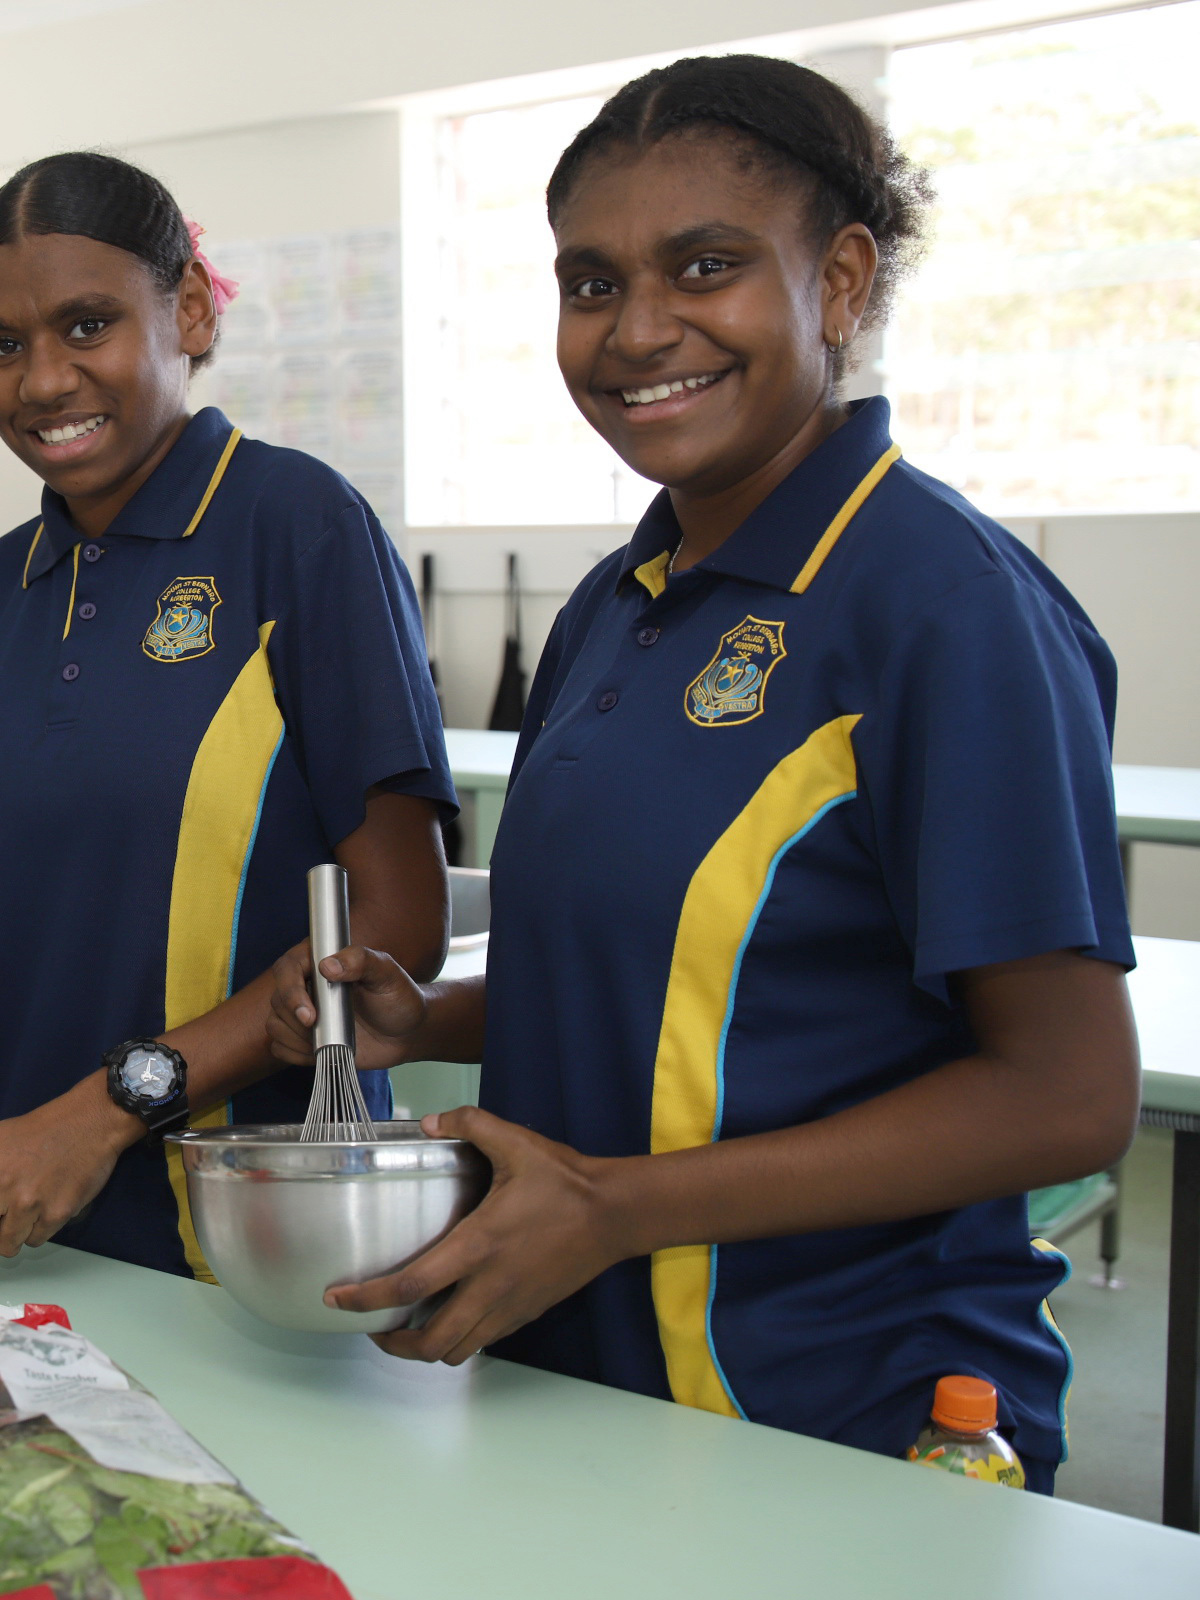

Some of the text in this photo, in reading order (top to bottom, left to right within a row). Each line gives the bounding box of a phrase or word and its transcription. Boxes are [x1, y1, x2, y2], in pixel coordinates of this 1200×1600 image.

[161, 583, 183, 601] MOUNT
[192, 580, 216, 602] BERNARD
[726, 625, 752, 645] MOUNT
[759, 626, 779, 655] BERNARD
